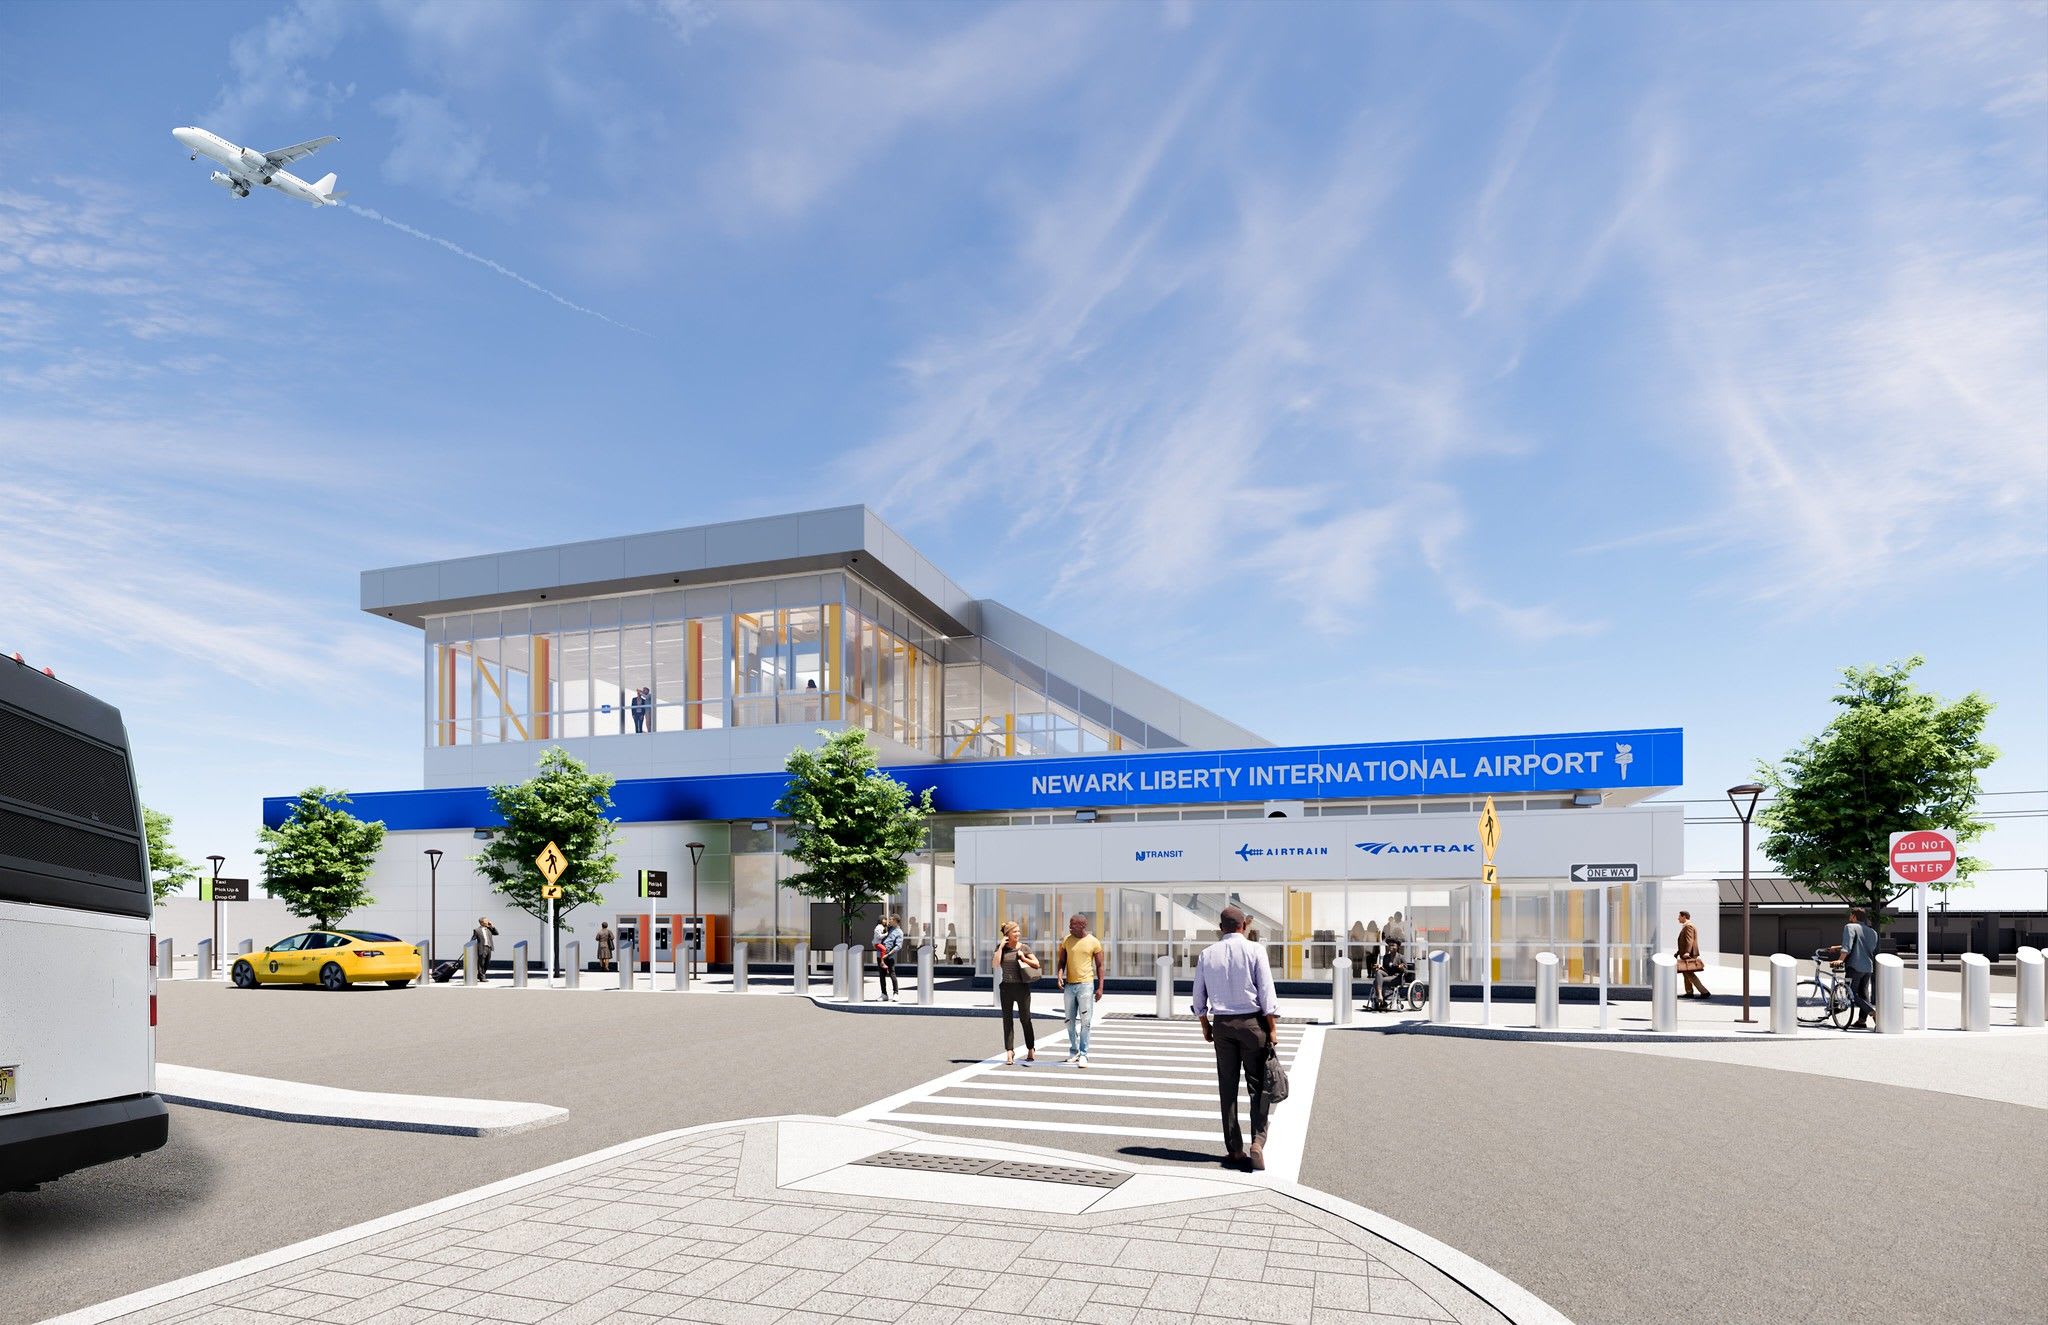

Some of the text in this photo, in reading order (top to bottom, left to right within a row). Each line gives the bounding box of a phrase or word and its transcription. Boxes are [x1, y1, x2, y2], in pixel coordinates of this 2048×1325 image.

[1032, 751, 1603, 795] NEWARK LIBERTY INTERNATIONAL AIRPORT
[1387, 844, 1475, 854] AMTRAK
[1900, 840, 1945, 851] DO NOT
[1145, 850, 1184, 858] TRANSIT
[1266, 847, 1328, 856] AIRTRAIN
[1587, 868, 1631, 877] ONE WAY
[1901, 863, 1944, 873] ENTER
